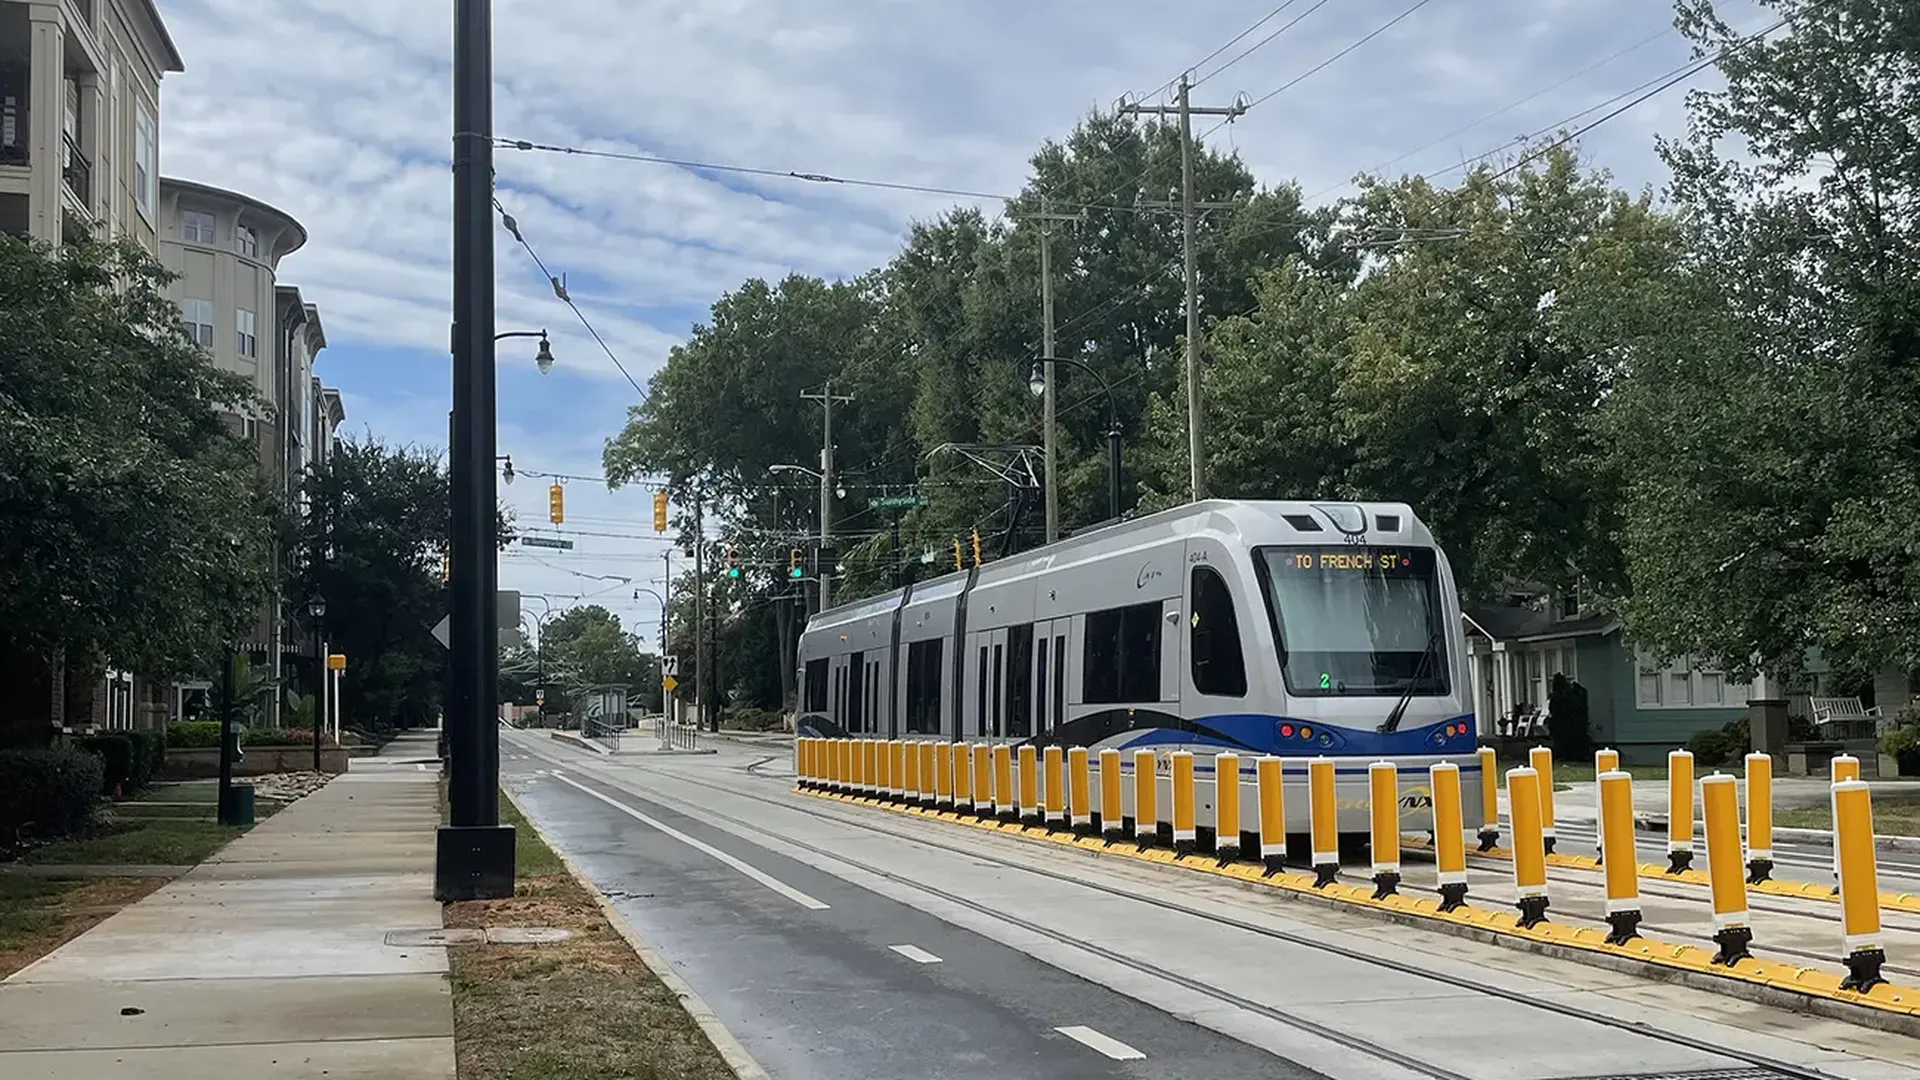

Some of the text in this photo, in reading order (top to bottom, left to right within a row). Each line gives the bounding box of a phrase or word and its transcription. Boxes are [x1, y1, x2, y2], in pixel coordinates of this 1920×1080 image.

[1344, 534, 1367, 545] 404
[1296, 555, 1397, 569] TO FRENCH ST
[1321, 673, 1330, 689] 2
